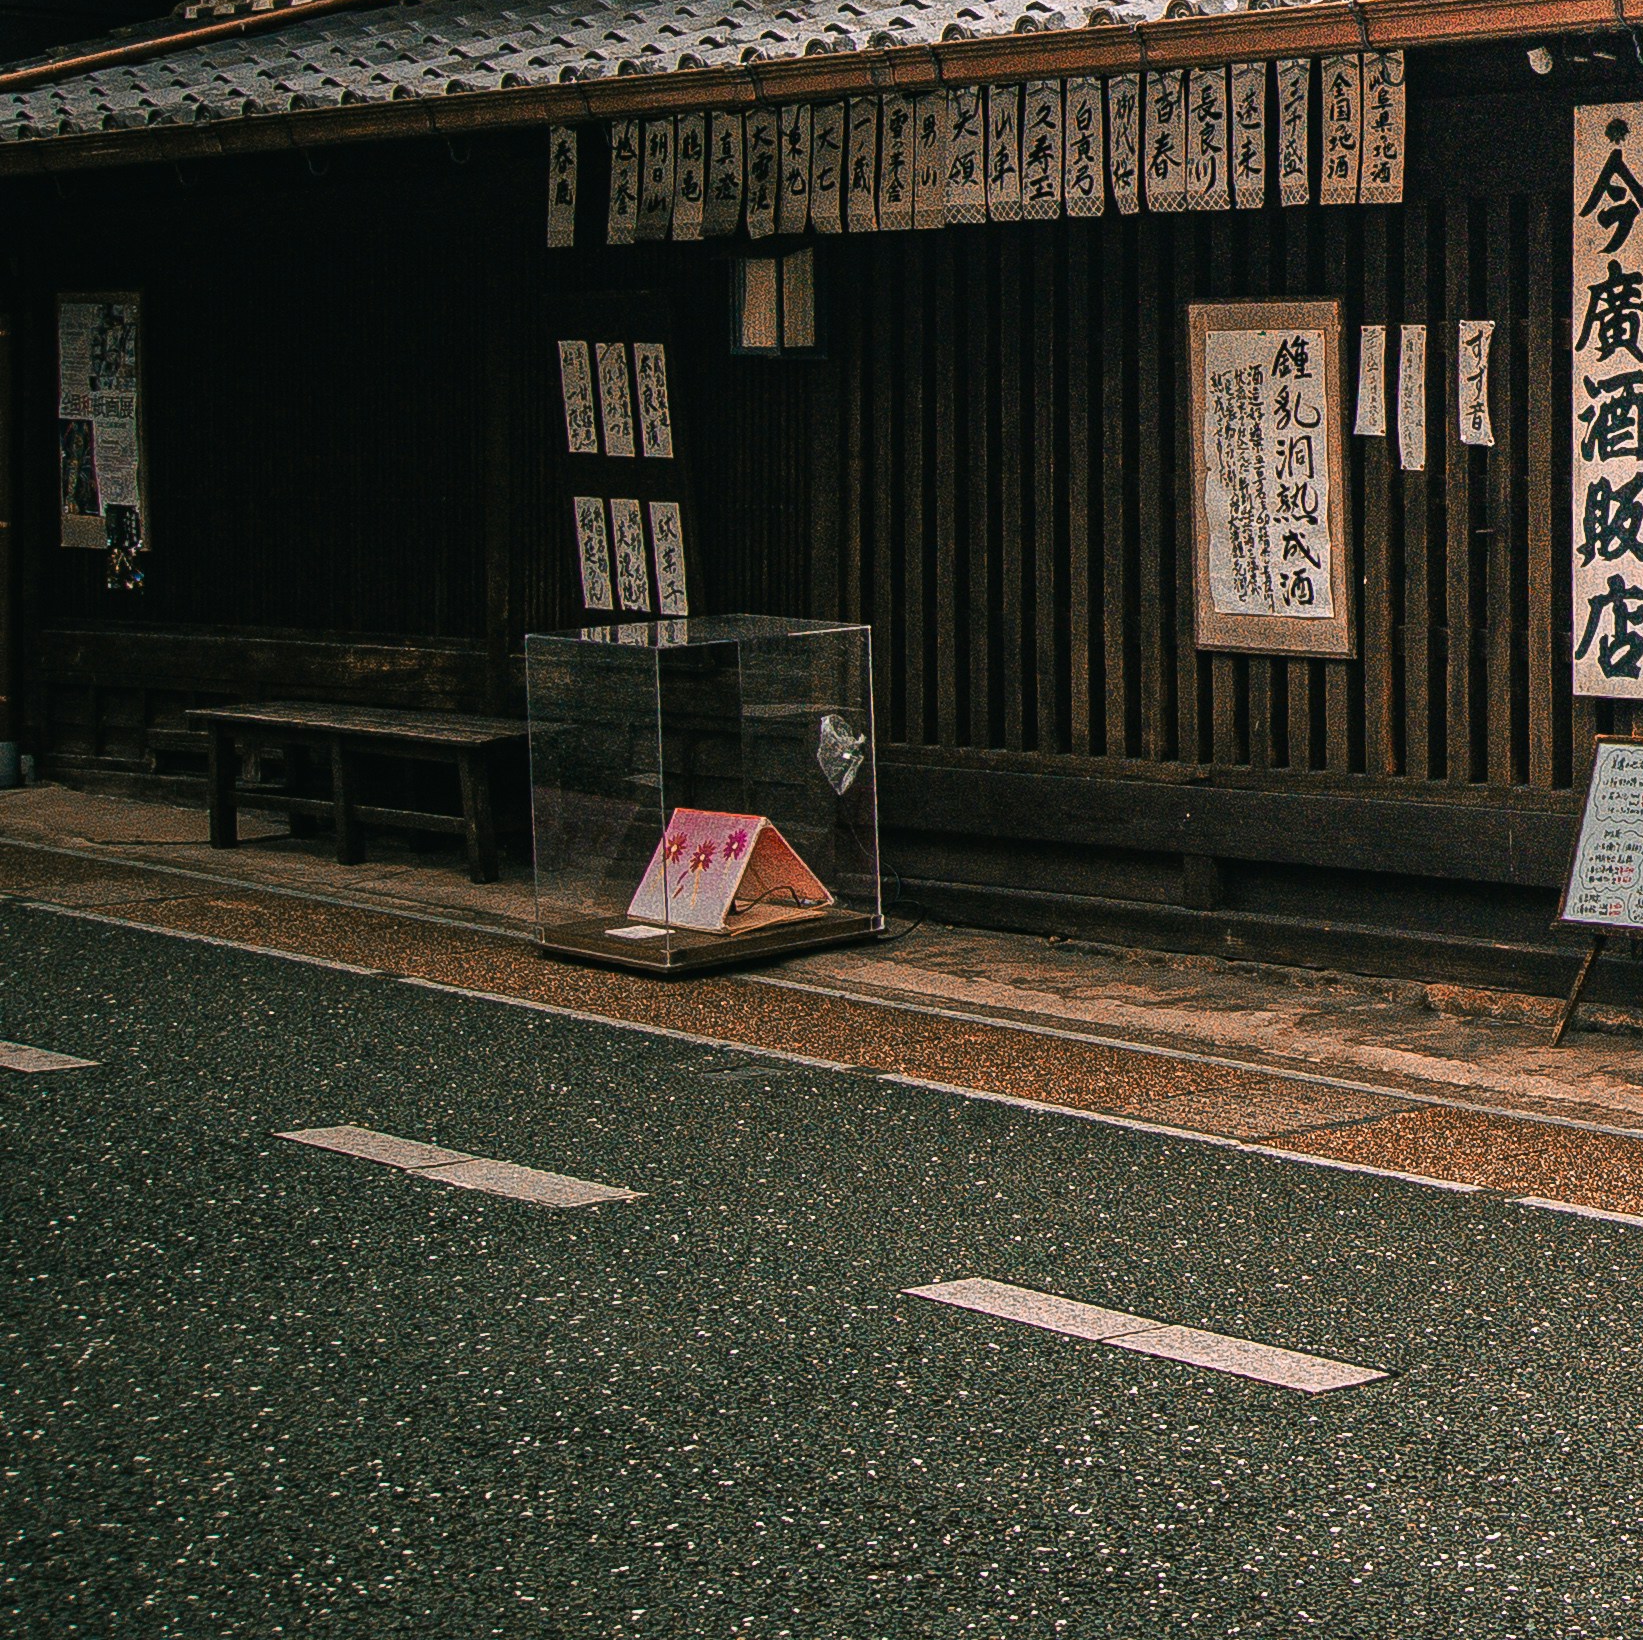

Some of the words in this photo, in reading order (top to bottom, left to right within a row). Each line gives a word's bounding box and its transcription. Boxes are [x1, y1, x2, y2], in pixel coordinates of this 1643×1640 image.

[646, 132, 669, 215] 朝日山
[816, 125, 840, 192] 大七
[920, 113, 939, 188] 男山
[1188, 83, 1223, 194] 長良川
